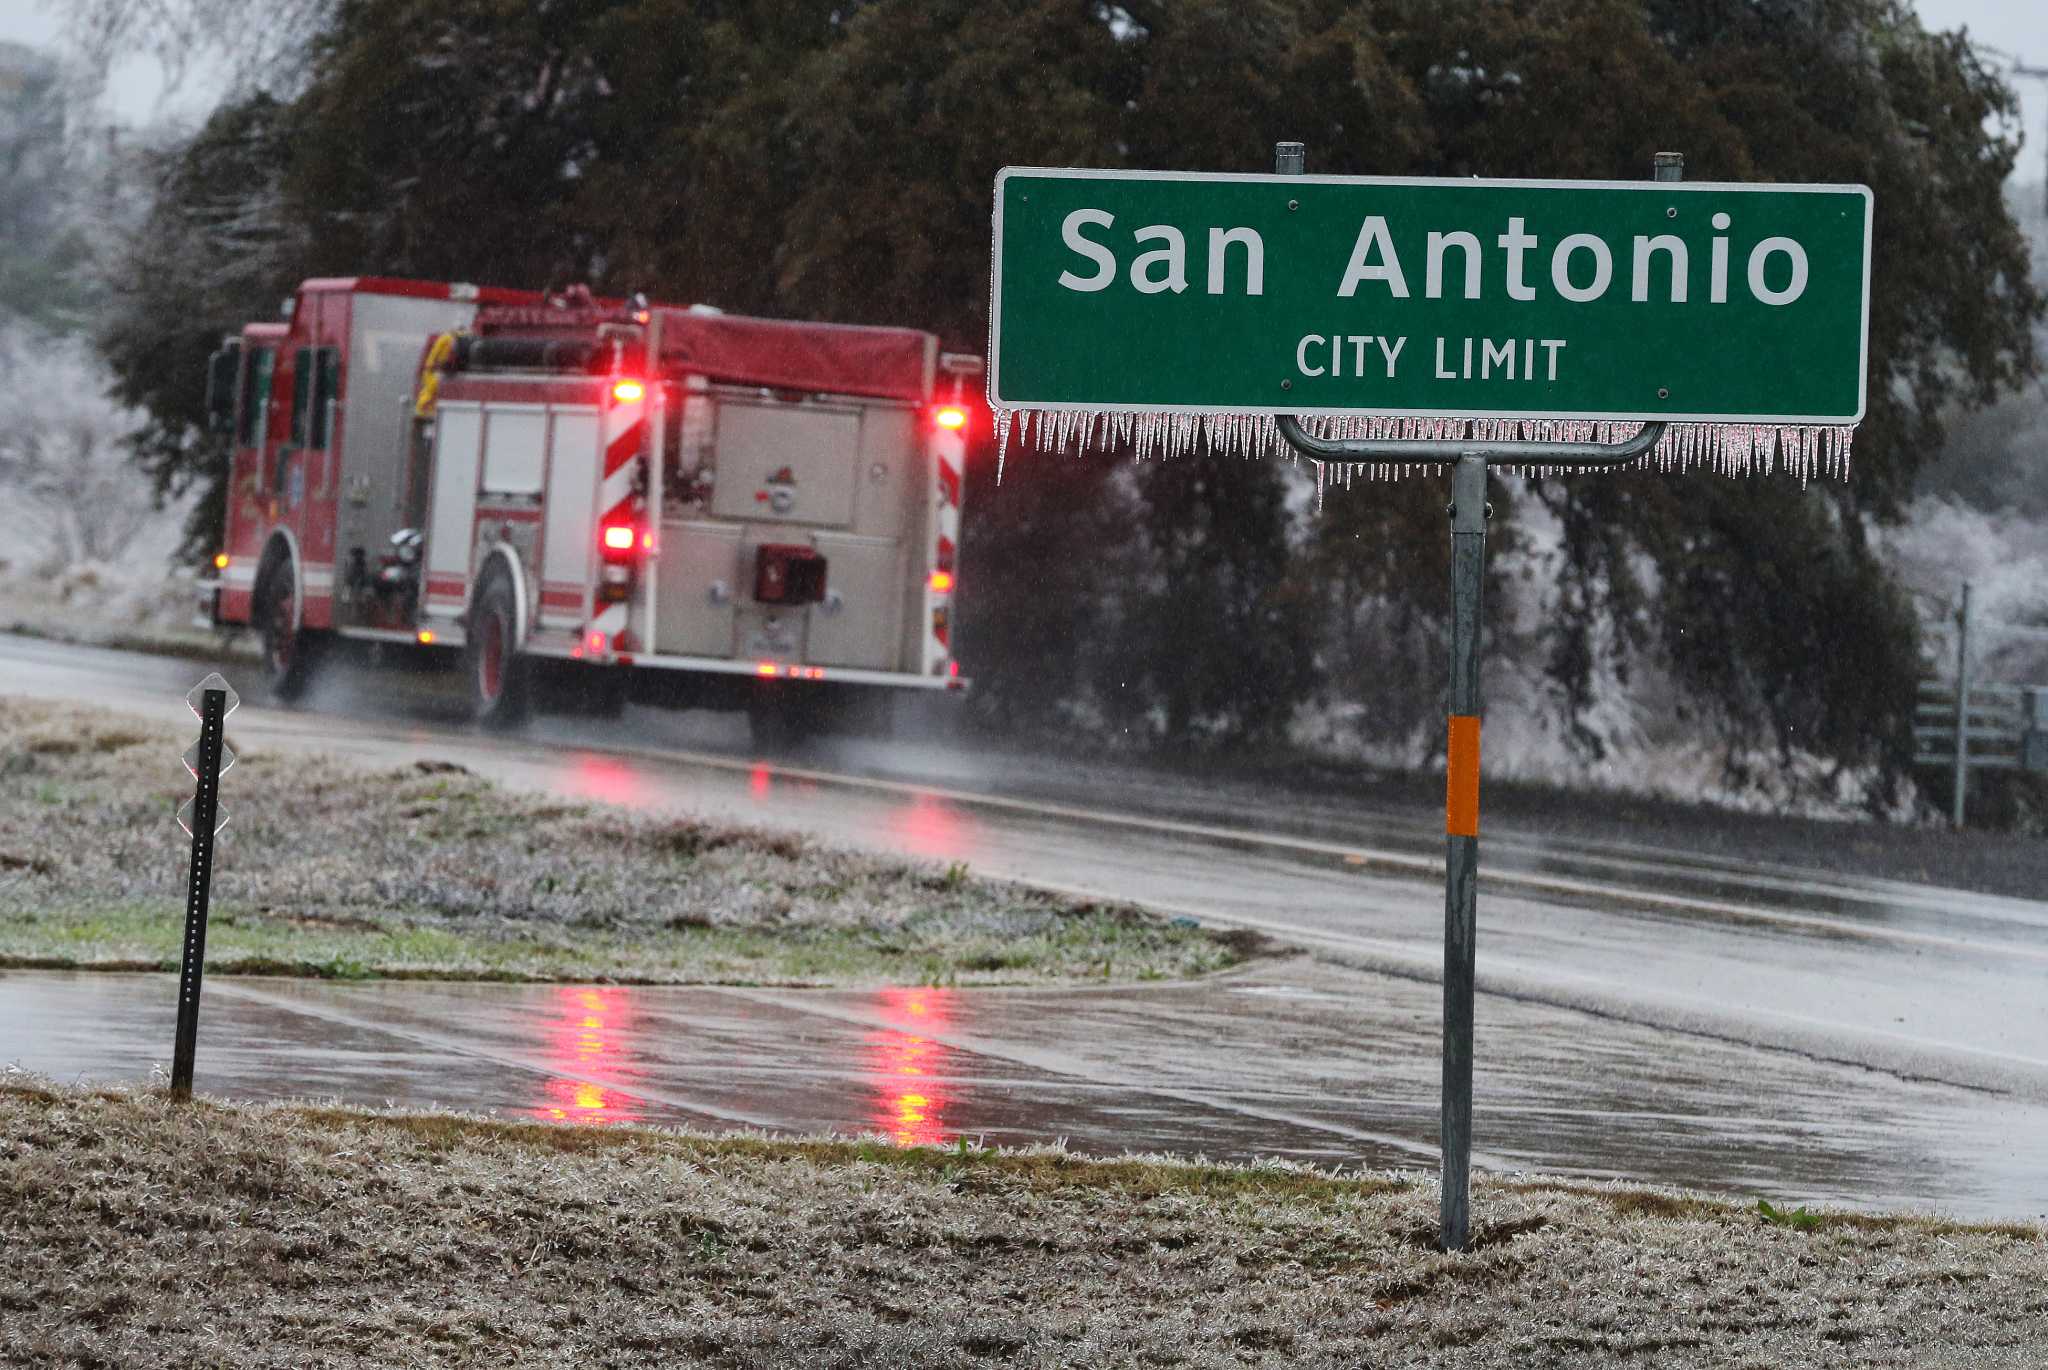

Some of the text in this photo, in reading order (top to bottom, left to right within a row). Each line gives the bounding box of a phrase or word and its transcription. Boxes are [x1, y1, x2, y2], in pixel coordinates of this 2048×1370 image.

[1058, 208, 1809, 306] San Antonio
[1296, 334, 1567, 381] CITY LIMIT
